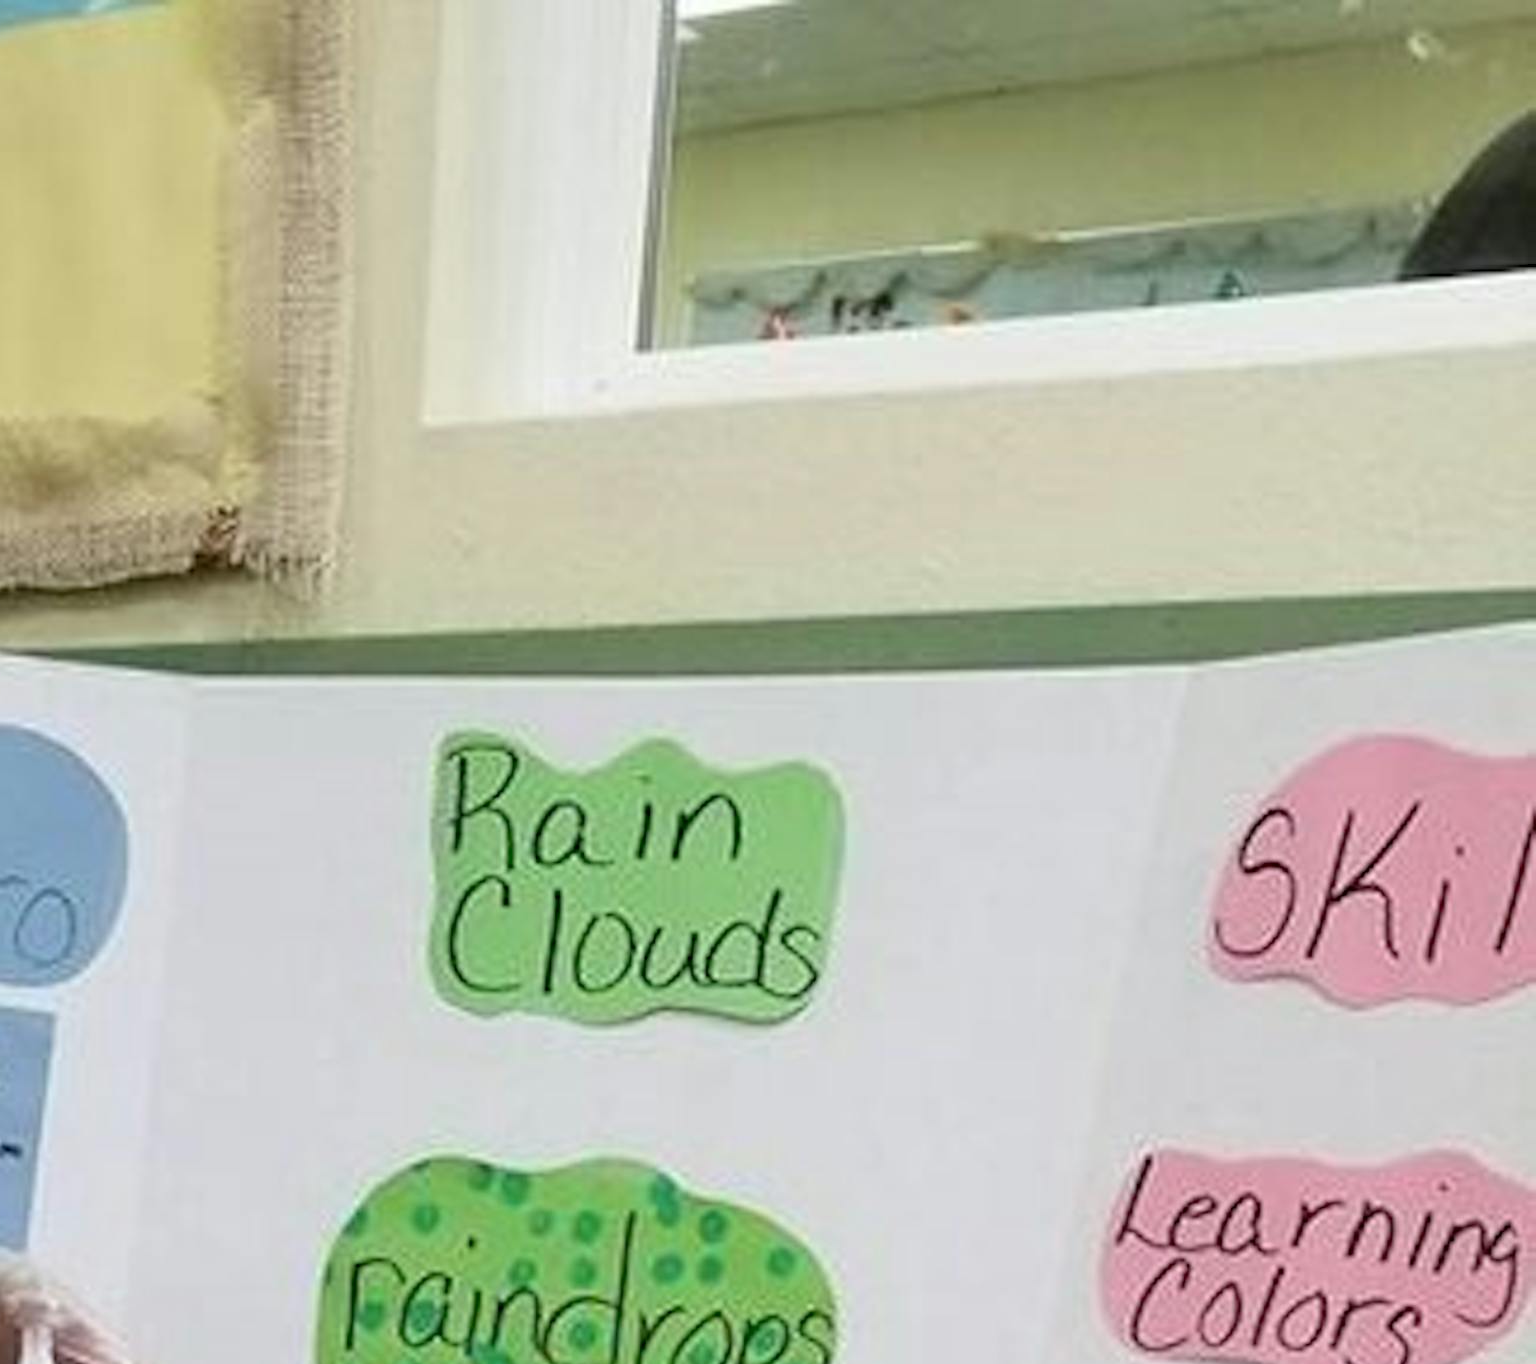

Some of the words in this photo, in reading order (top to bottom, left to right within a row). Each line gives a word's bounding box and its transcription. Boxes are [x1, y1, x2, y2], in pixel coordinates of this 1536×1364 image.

[446, 745, 744, 871] Rain
[448, 876, 821, 1000] Clouds
[1215, 800, 1536, 962] SKil
[1117, 1155, 1520, 1328] Learning
